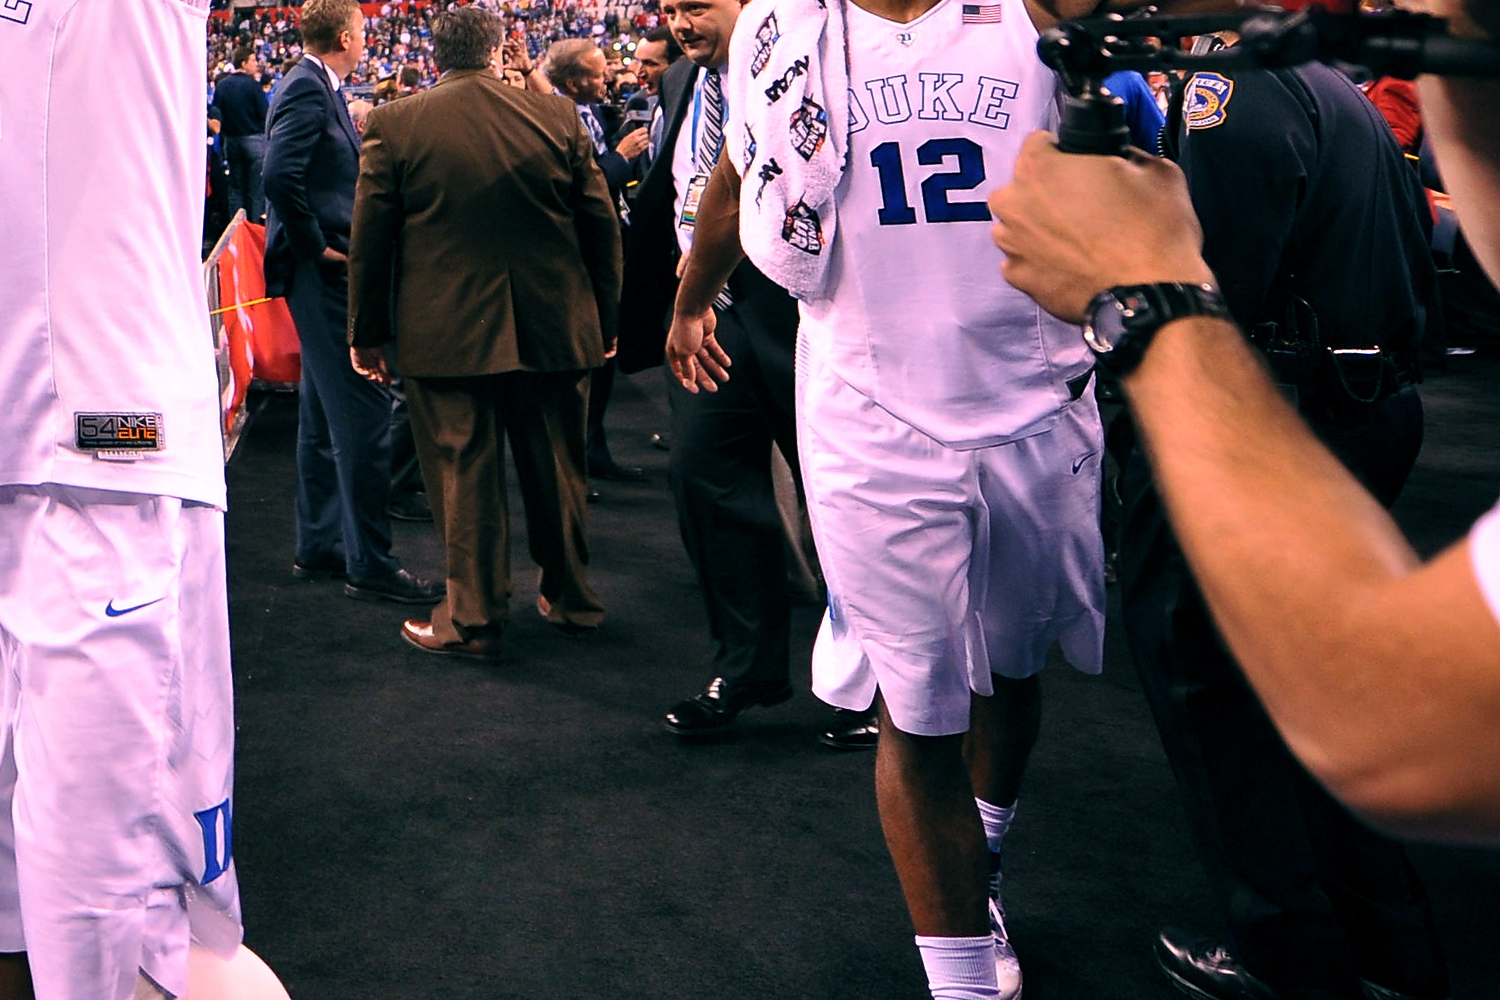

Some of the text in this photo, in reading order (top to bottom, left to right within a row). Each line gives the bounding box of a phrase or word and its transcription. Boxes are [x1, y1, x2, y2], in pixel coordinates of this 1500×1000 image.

[869, 137, 992, 226] 12
[82, 416, 156, 438] 54 NIKE
